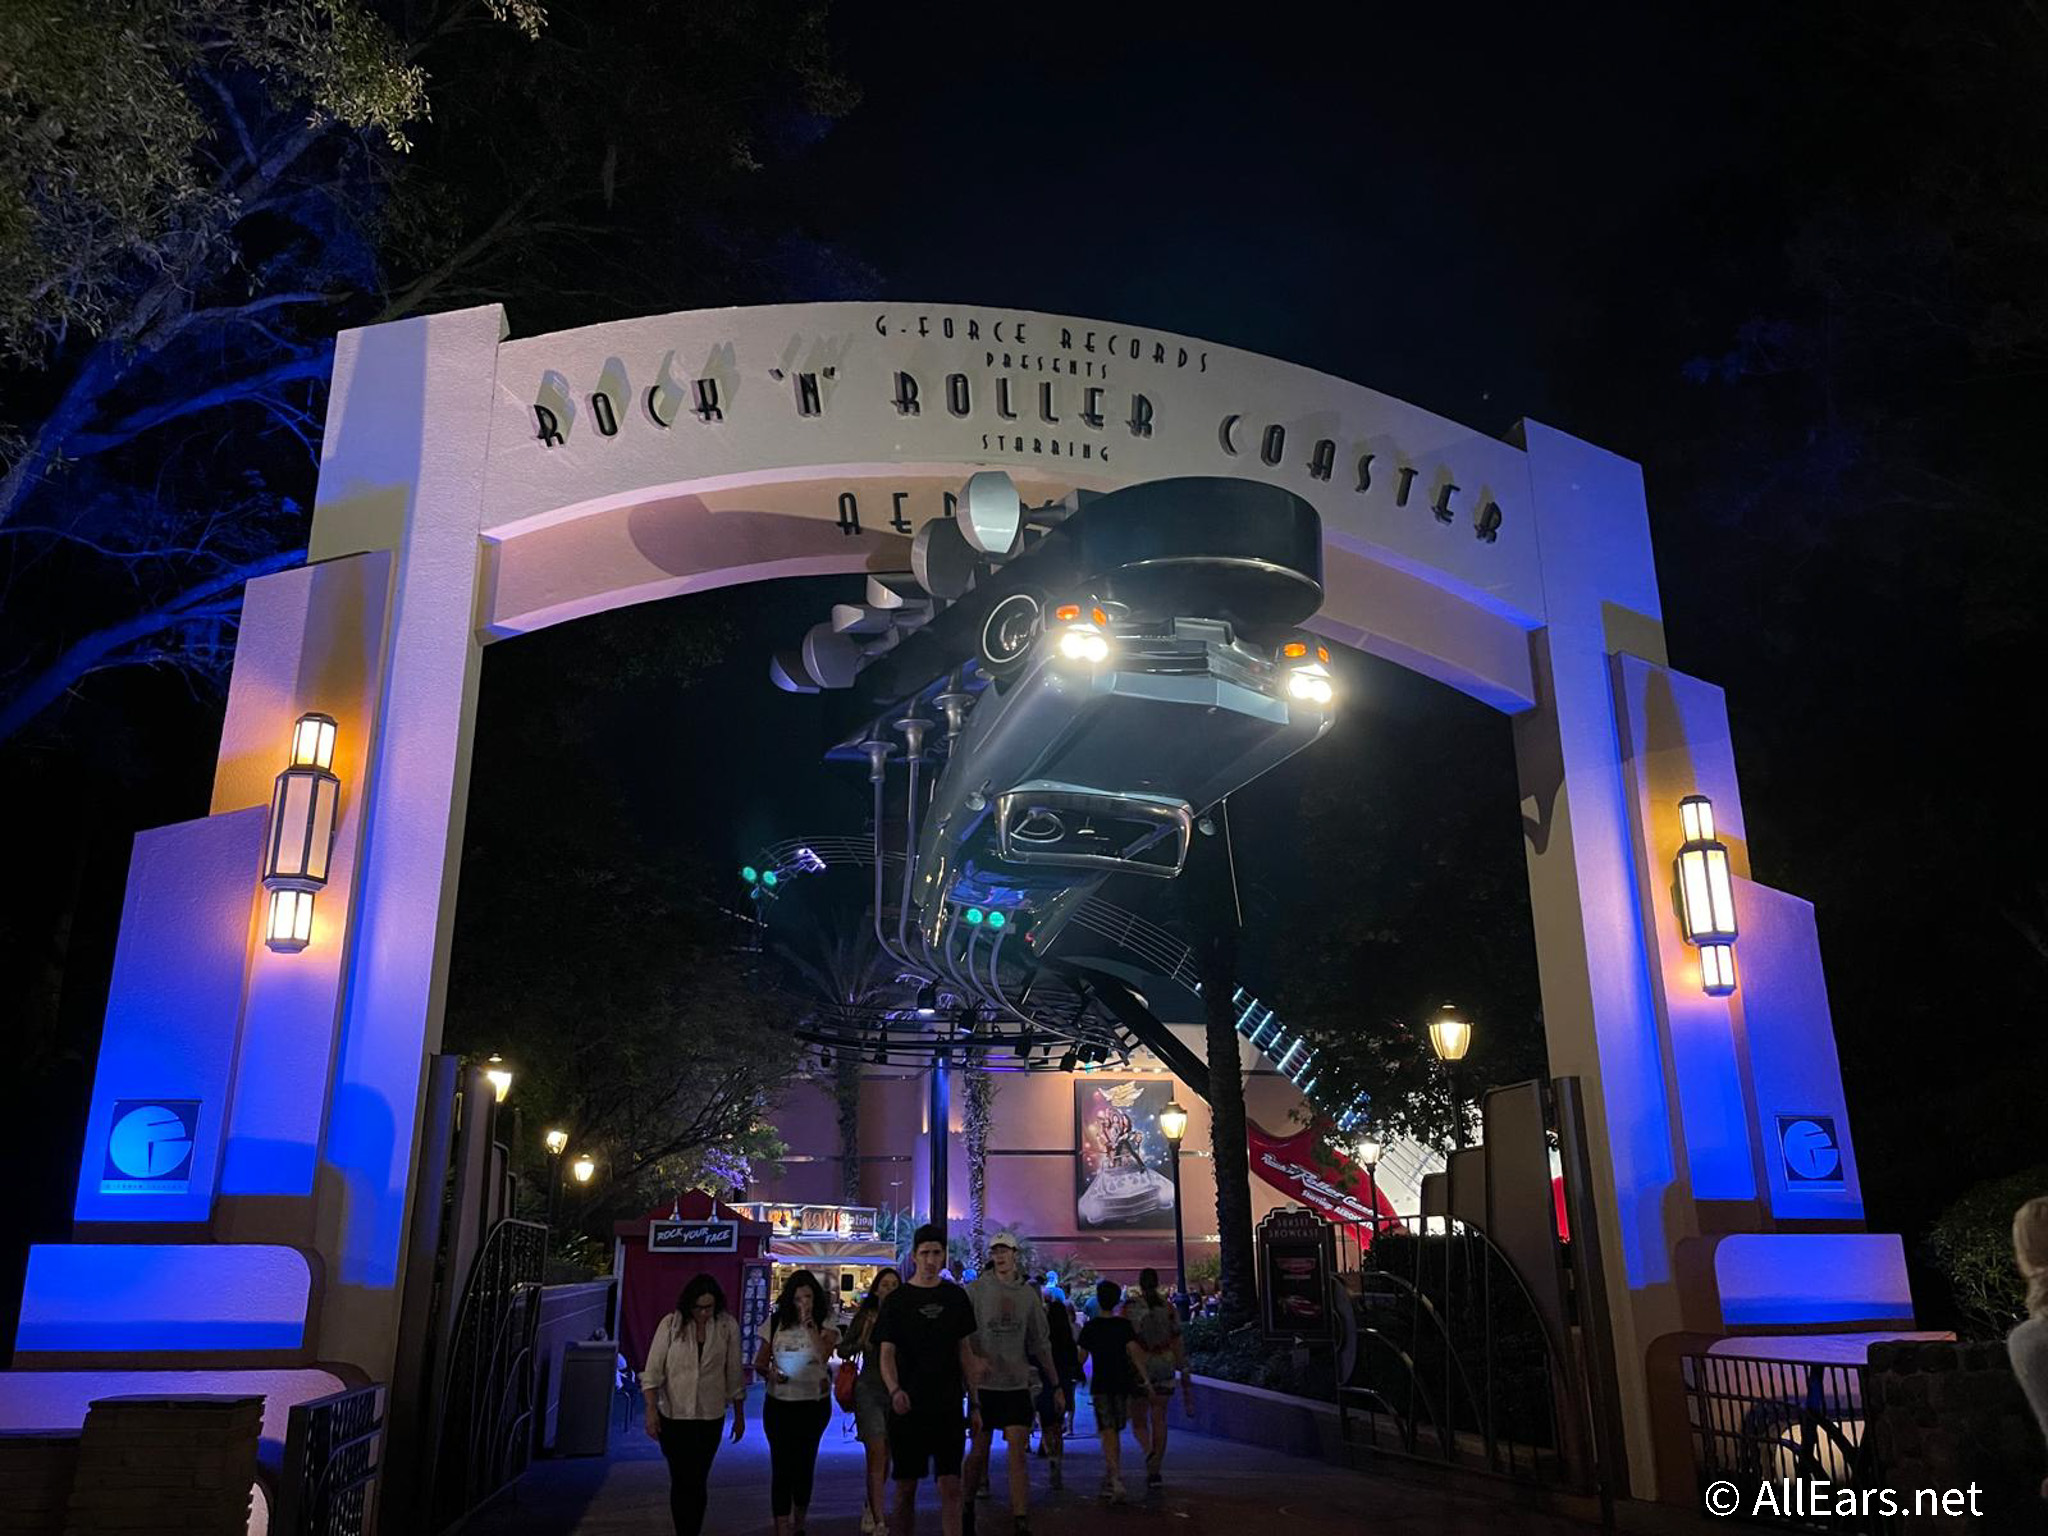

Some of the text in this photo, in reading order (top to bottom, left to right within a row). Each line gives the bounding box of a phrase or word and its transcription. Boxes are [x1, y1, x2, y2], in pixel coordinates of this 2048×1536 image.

[1060, 328, 1207, 373] RECORDS
[986, 352, 1107, 379] PRESENTS
[532, 376, 724, 448] ROCK
[891, 371, 1154, 438] ROLLER
[1218, 414, 1503, 543] COASTER
[981, 434, 1109, 462] STARRING
[656, 1226, 731, 1245] ROCK YOUR FACE
